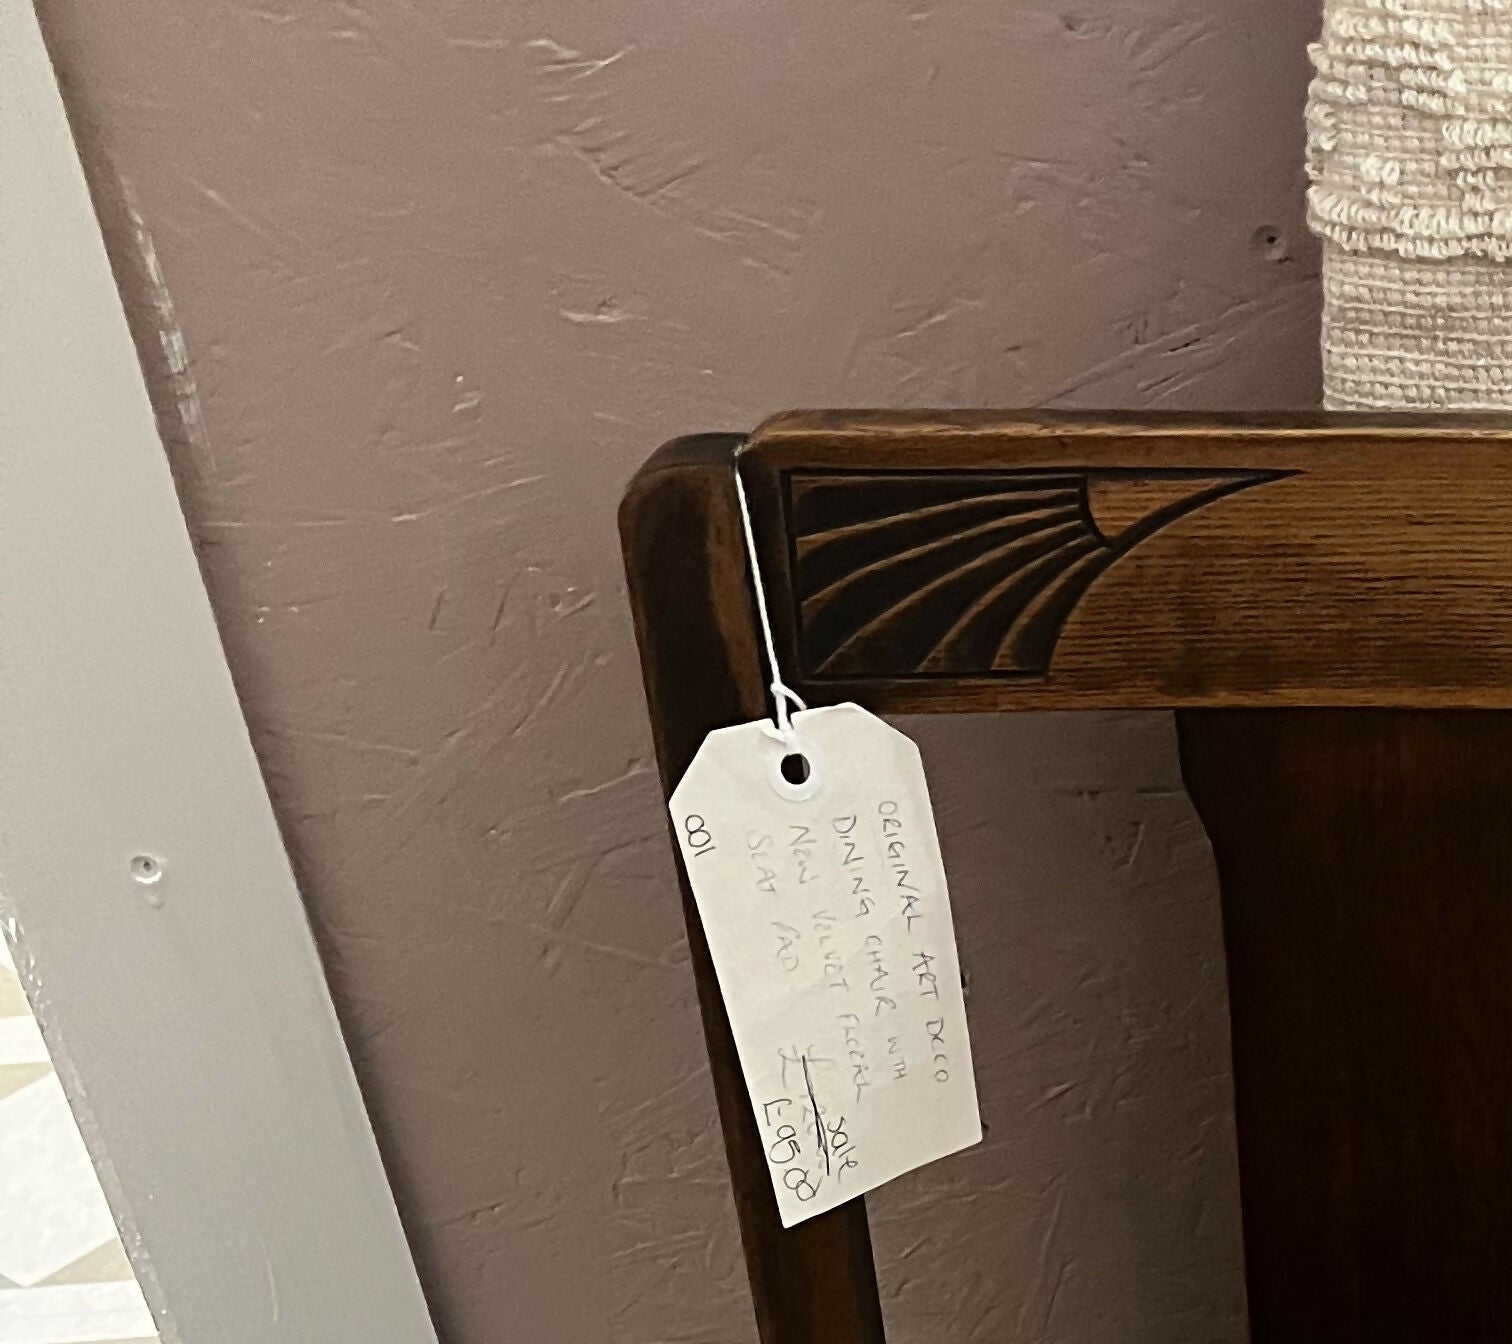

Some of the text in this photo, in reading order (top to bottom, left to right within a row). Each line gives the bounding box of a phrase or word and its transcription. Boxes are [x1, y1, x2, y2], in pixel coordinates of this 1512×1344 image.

[684, 814, 716, 858] 001
[832, 814, 875, 918] DINING
[864, 934, 897, 1017] CHAIR
[878, 800, 950, 1083] ORIGINAL ART DECO
